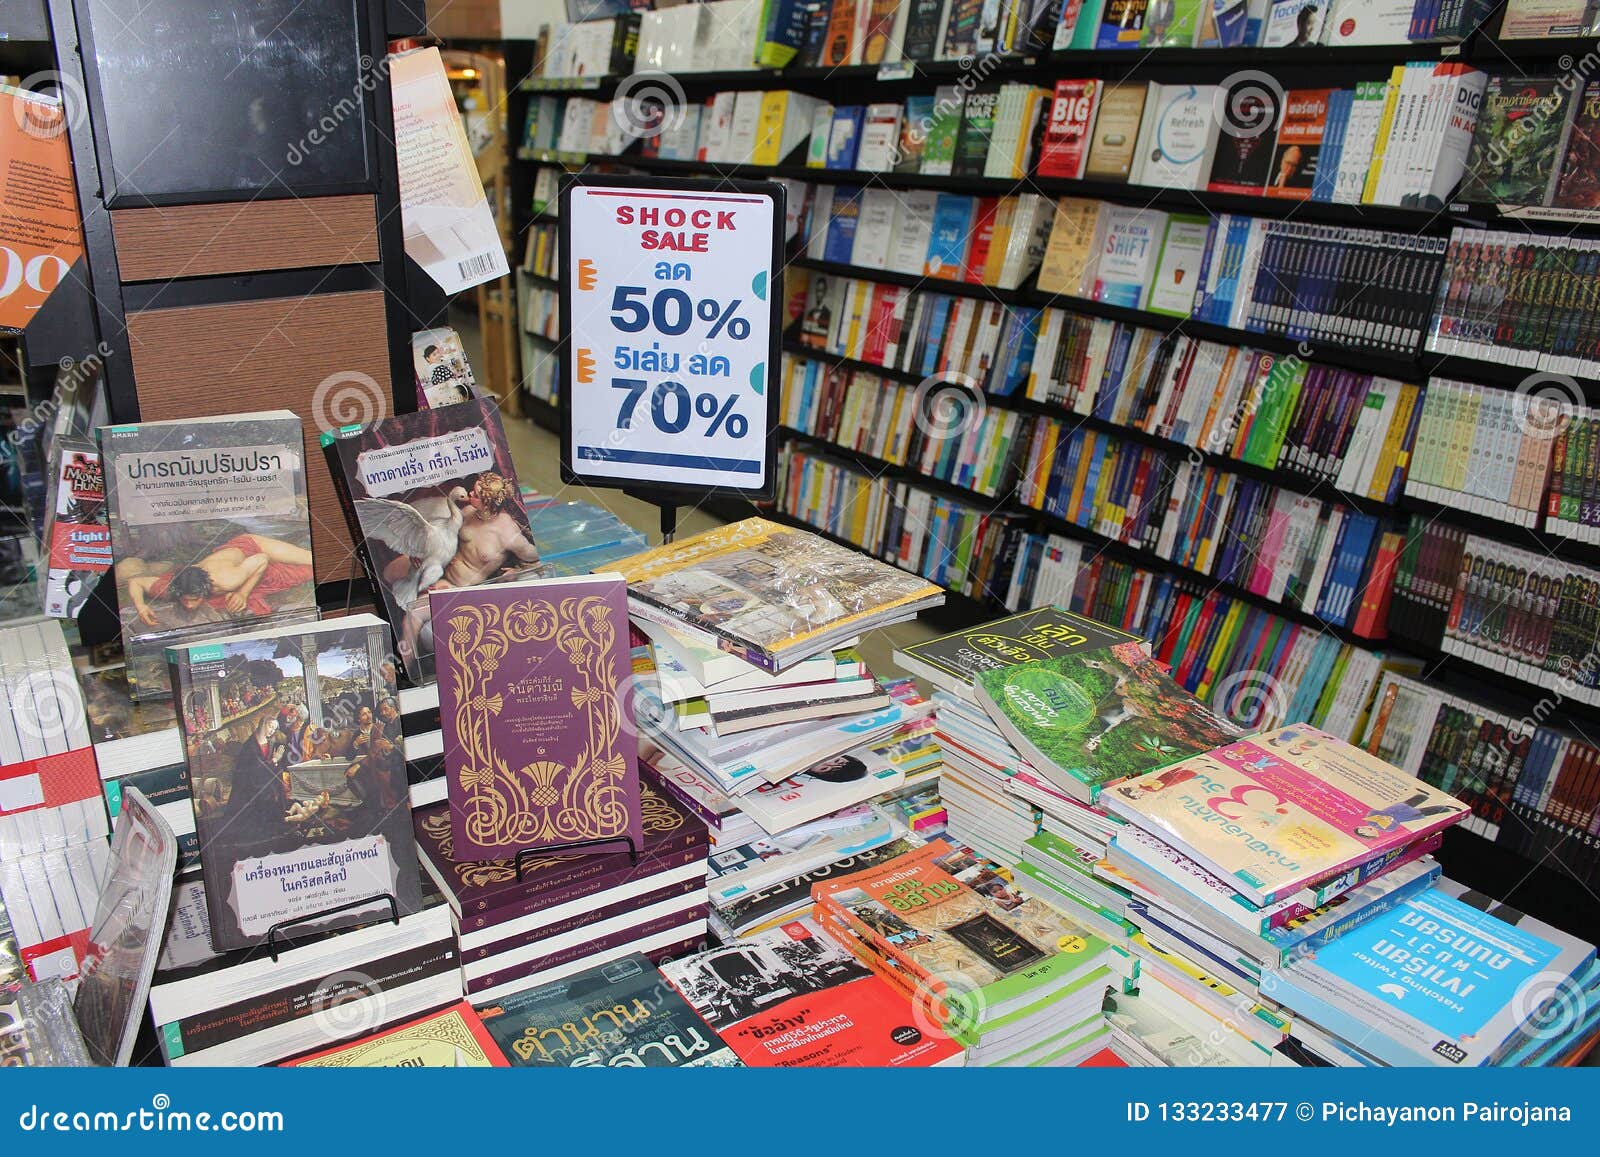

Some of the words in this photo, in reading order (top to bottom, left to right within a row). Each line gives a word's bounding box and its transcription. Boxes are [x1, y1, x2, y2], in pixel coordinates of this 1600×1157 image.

[1052, 98, 1090, 121] BIG
[1184, 106, 1197, 115] Hit
[1450, 116, 1461, 126] IN
[1170, 115, 1205, 129] Refresh
[616, 205, 736, 231] SHOCK
[640, 230, 709, 252] SALE
[1106, 234, 1150, 258] SHIFT
[654, 261, 692, 282] ลด
[609, 285, 751, 341] 50%
[613, 342, 680, 374] 5เล่ม
[688, 354, 730, 377] ลด
[611, 377, 749, 439] 70%
[66, 466, 104, 485] MONS
[128, 450, 282, 480] ปกรณัมปรัมปรา
[366, 453, 424, 486] เทวดาฝรั่ง
[428, 442, 489, 471] กรีก-โรมัน
[215, 494, 267, 505] Mythology
[71, 530, 99, 544] Light
[1020, 633, 1055, 650] เป็น
[1032, 623, 1089, 647] เลิก
[957, 647, 1005, 670] CHOOSE
[1003, 684, 1057, 728] Amazing
[1042, 687, 1067, 710] ไทย
[1193, 773, 1225, 795] วัน
[1207, 784, 1288, 821] 3
[245, 843, 379, 883] เครื่องหมายและสัญลักษณ์
[280, 866, 348, 894] ในคริสตศิลป์
[871, 866, 922, 888] ความเป็นมา
[896, 878, 923, 894] คน
[881, 879, 960, 912] อีสาน
[1352, 950, 1398, 979] Twitter
[1402, 975, 1465, 1013] Hatching
[511, 998, 651, 1061] ตำนาน
[1439, 1043, 1464, 1058] CUT
